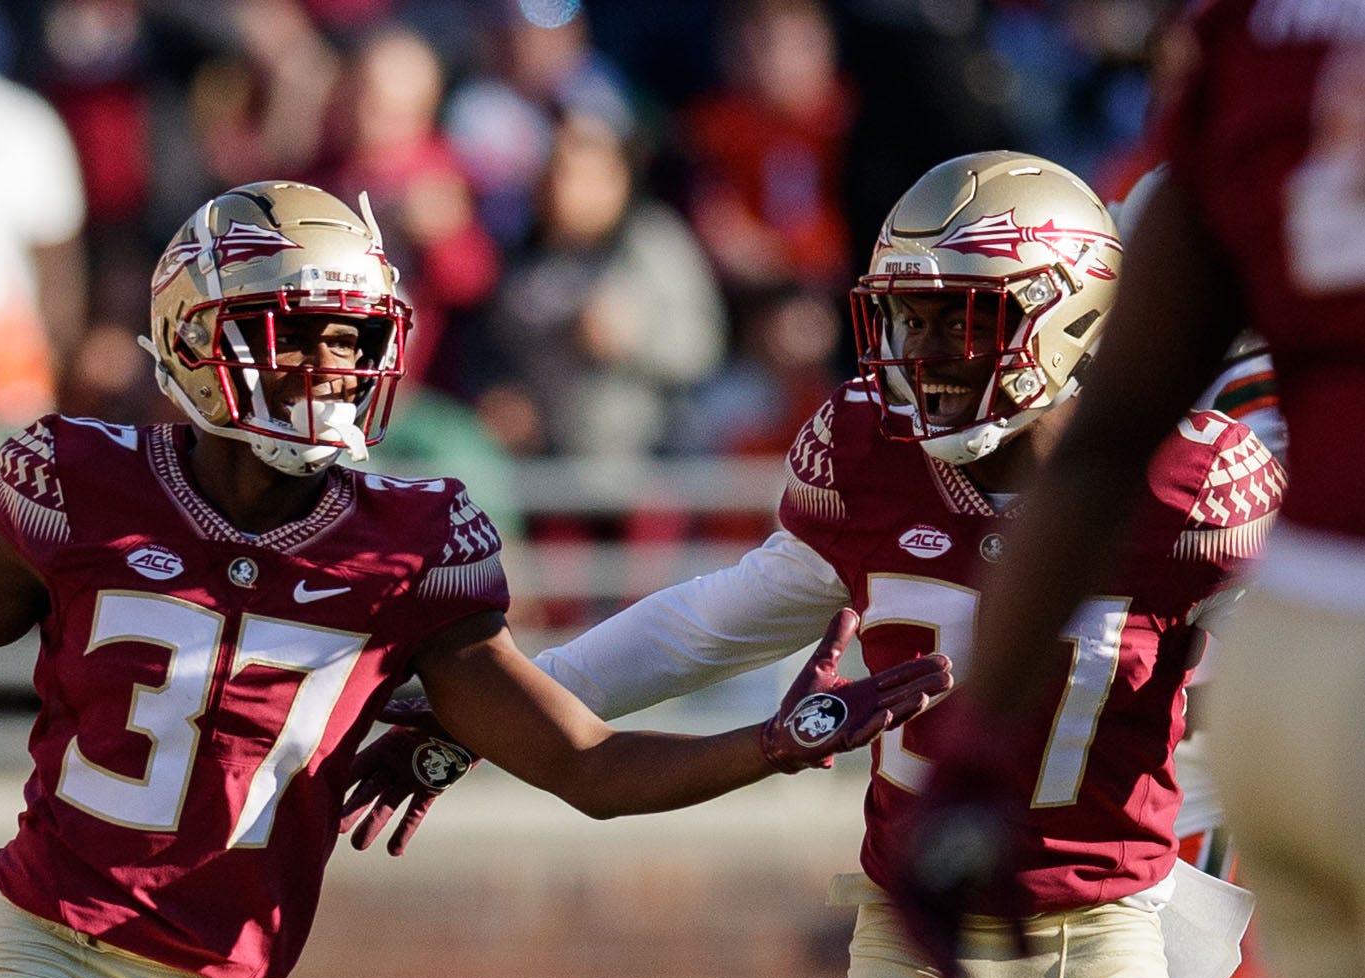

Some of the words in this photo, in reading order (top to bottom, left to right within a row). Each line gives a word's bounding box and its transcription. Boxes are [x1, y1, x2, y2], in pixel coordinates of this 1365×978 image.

[885, 262, 921, 274] NOLES
[905, 533, 947, 548] ACC
[135, 553, 179, 571] ACC
[55, 589, 372, 850] 37
